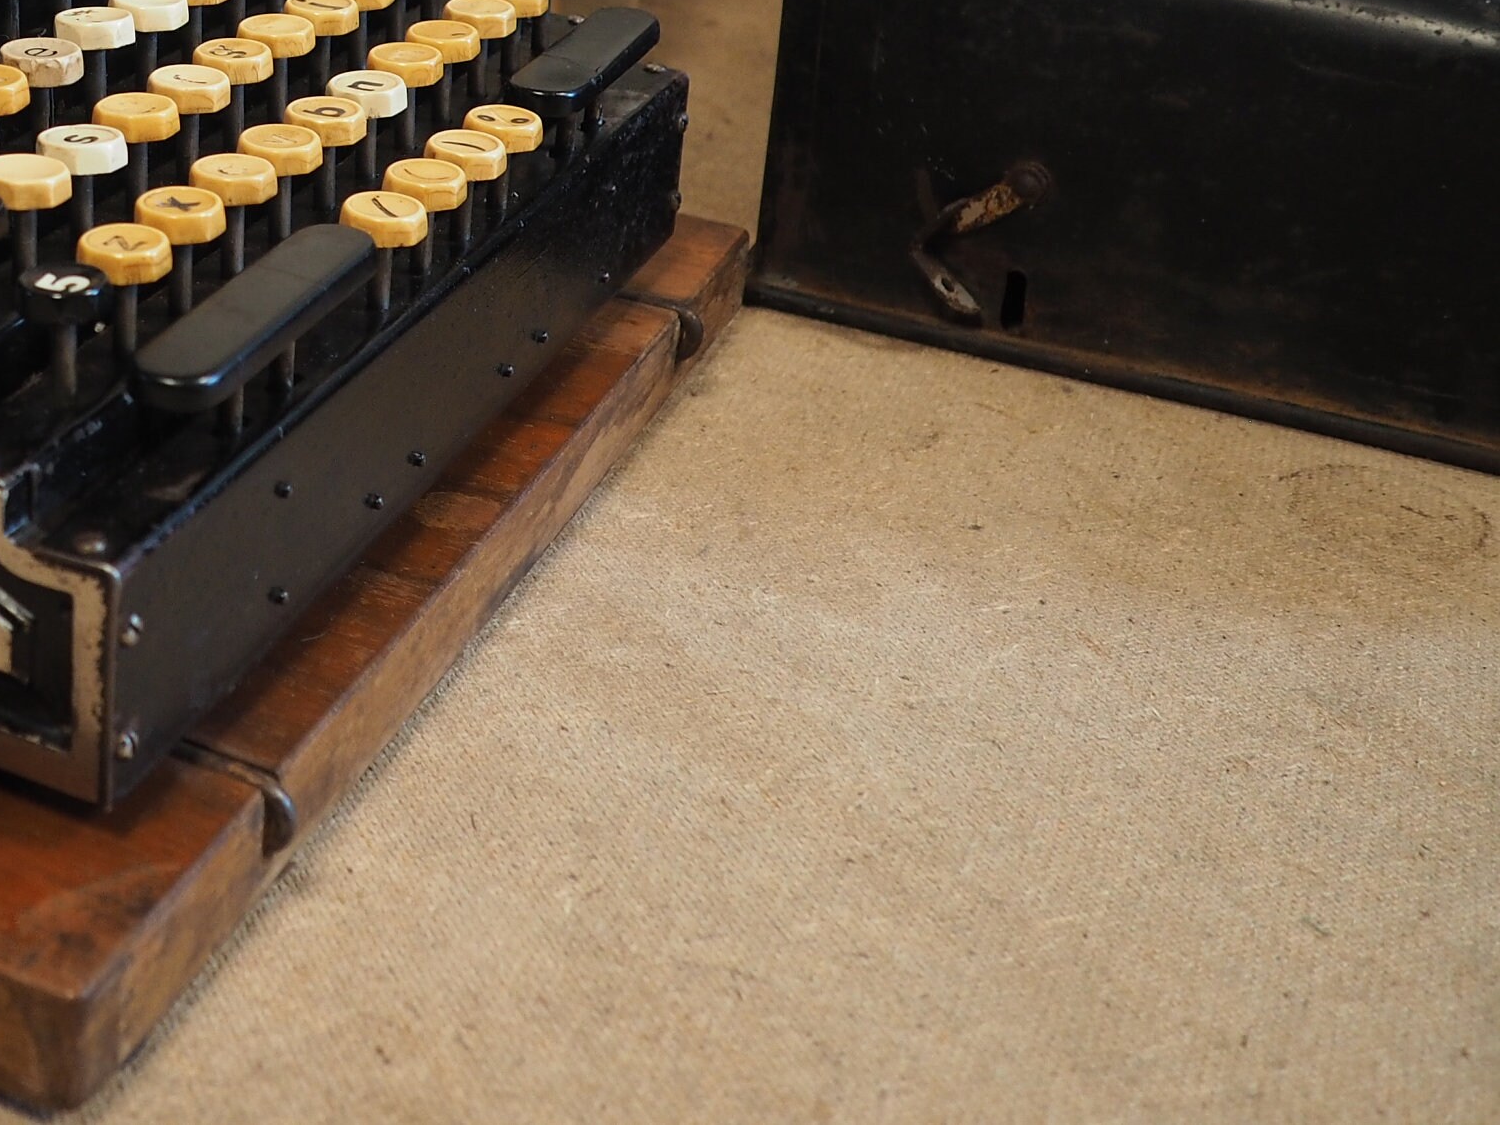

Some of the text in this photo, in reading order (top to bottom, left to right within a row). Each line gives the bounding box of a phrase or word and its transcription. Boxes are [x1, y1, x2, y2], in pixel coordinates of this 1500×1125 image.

[24, 47, 58, 58] e
[303, 106, 347, 118] b
[34, 272, 92, 294] 5
